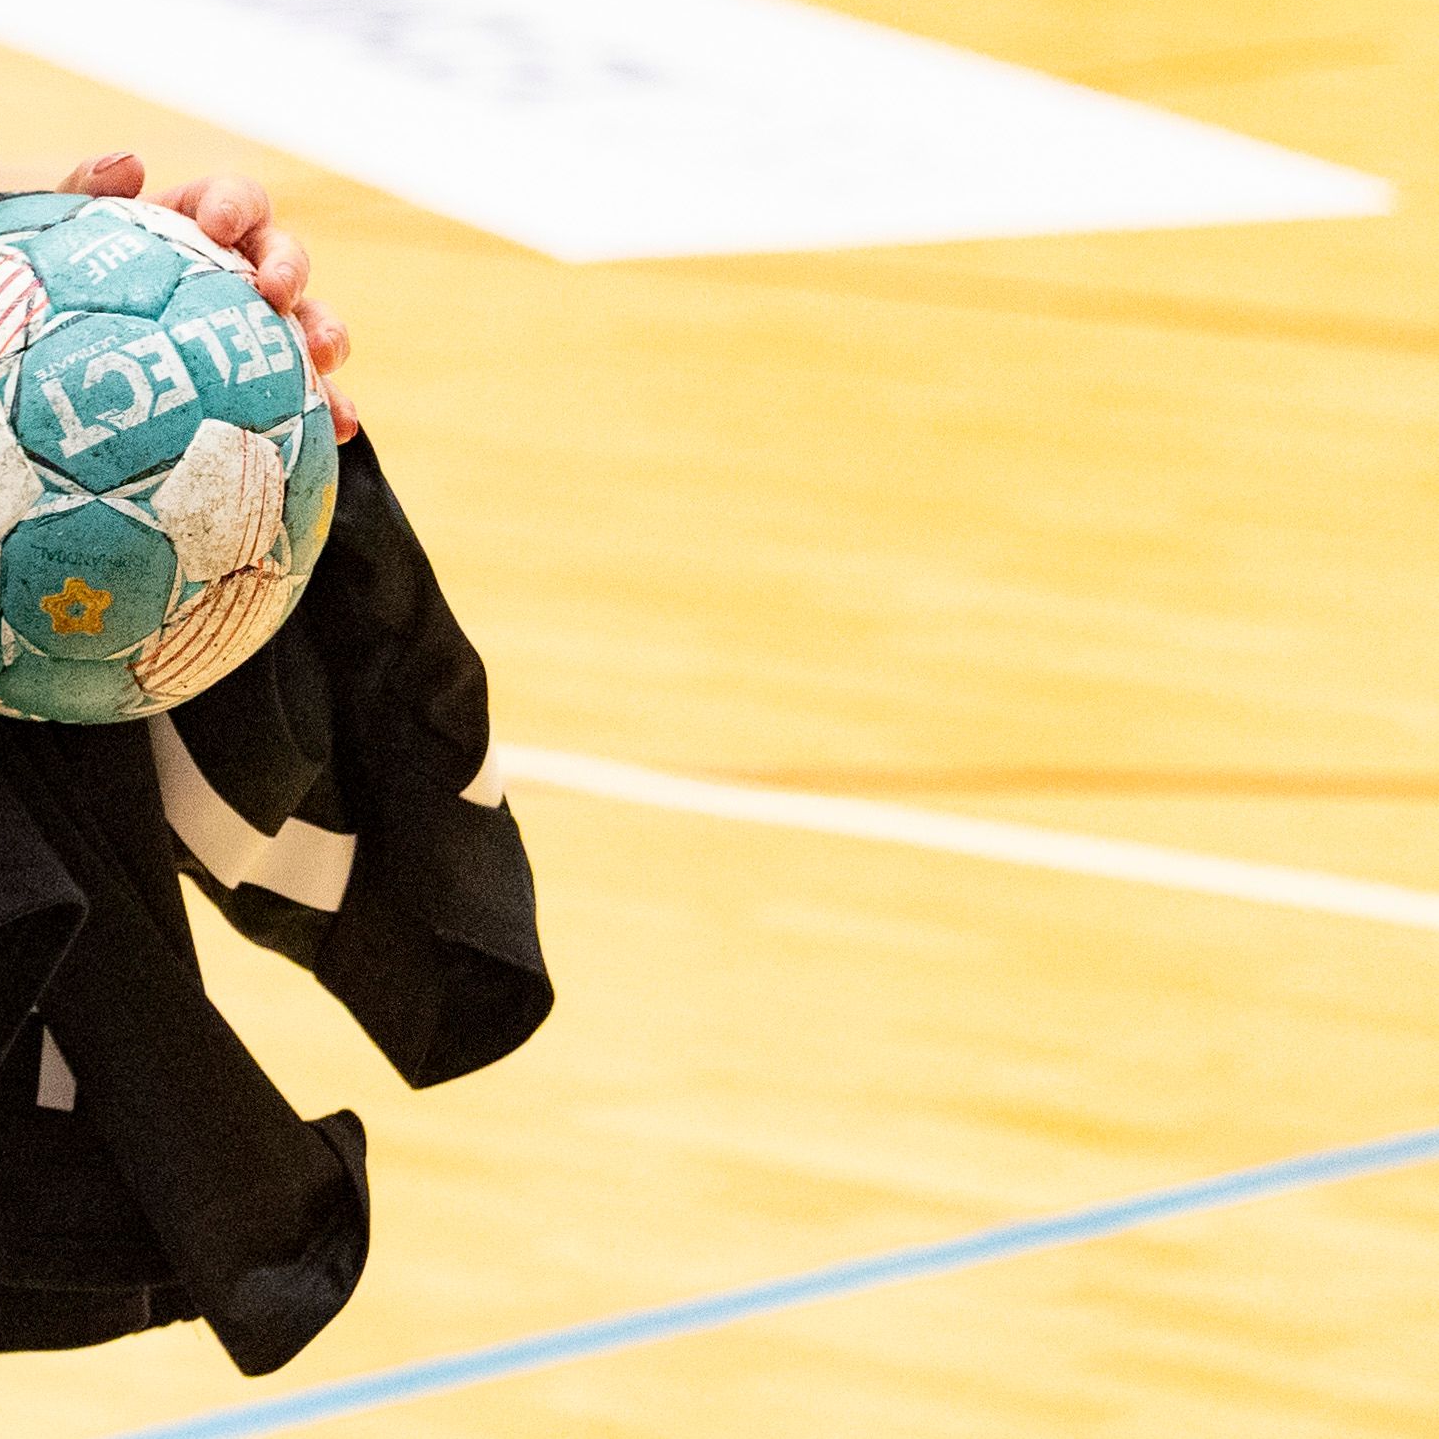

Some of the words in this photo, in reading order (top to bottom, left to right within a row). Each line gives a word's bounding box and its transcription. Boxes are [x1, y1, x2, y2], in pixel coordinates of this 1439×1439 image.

[84, 232, 146, 286] EHF
[32, 335, 121, 382] ULTIMATE
[39, 299, 296, 460] SELECT
